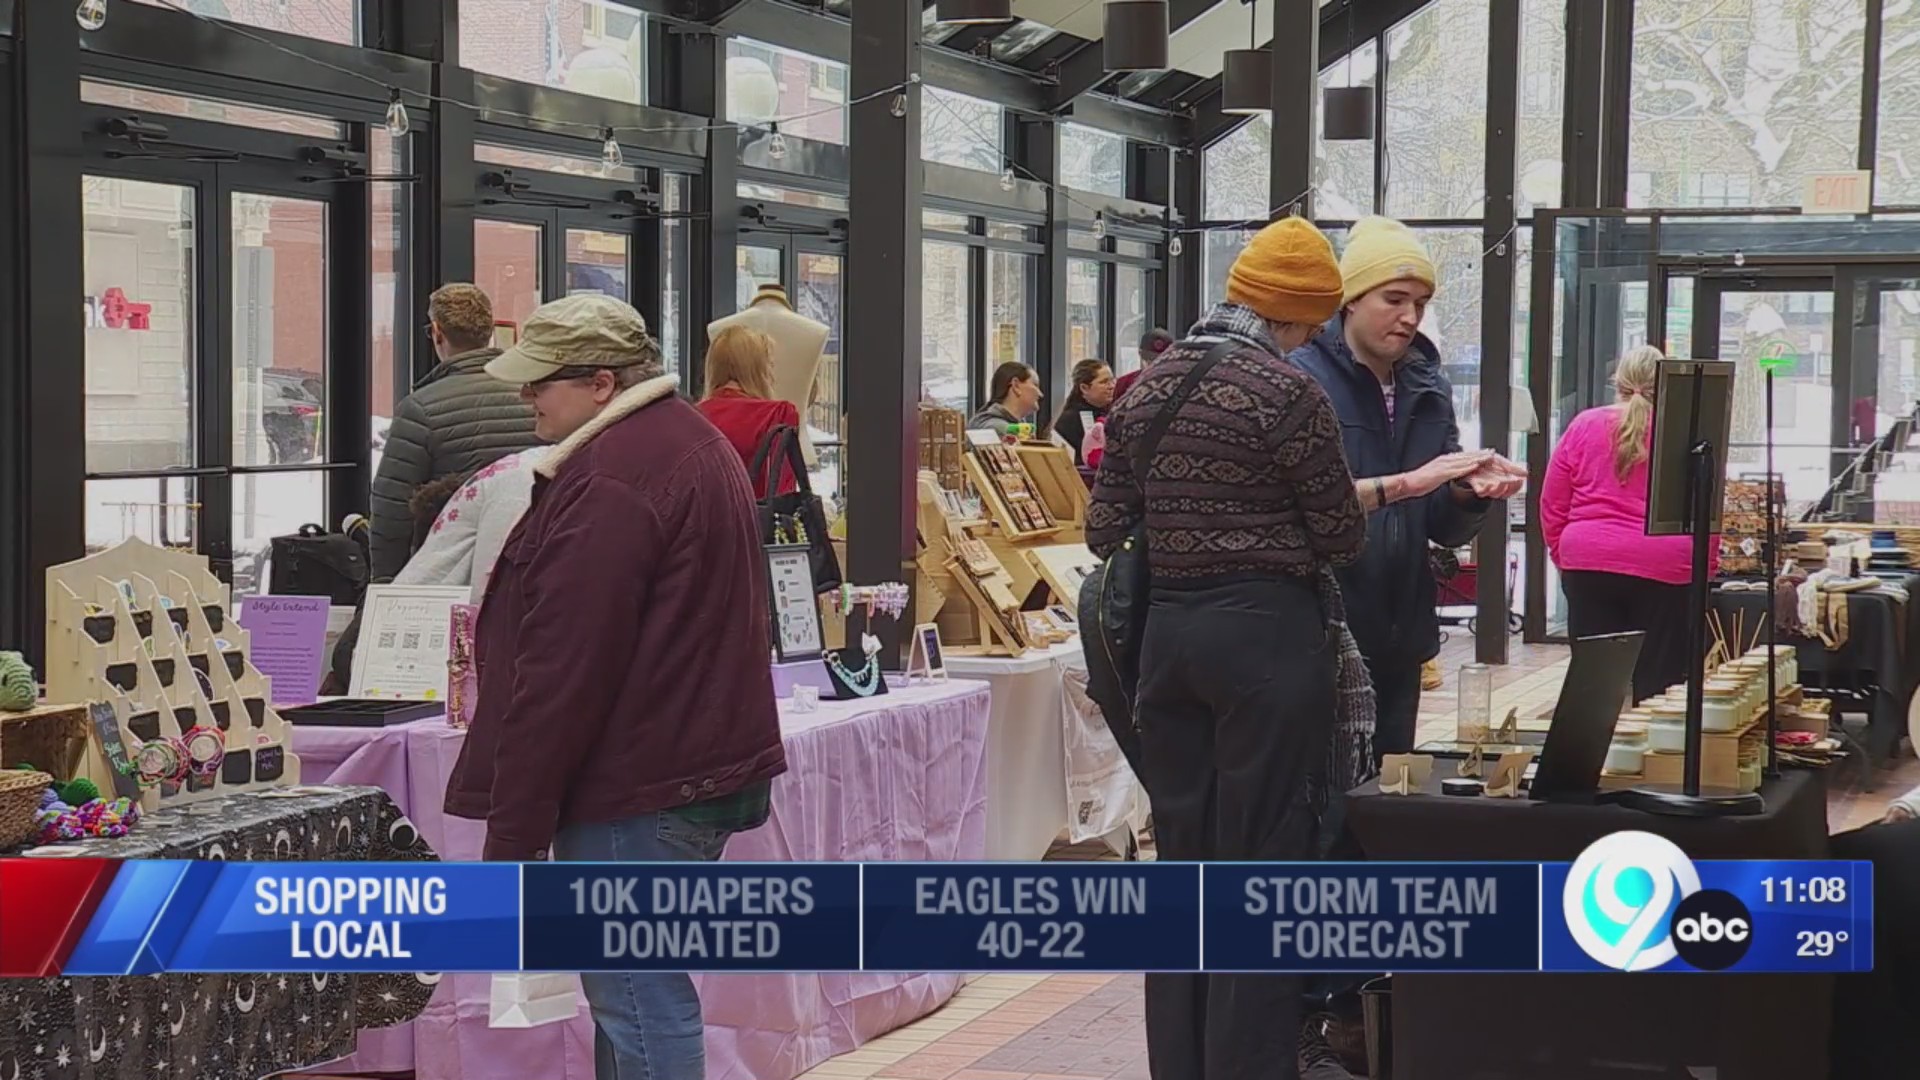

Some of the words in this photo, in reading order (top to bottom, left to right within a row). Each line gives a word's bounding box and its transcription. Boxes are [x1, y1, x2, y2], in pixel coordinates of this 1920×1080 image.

[1814, 176, 1858, 208] EXIT
[252, 601, 280, 613] Style
[282, 602, 320, 612] Extend
